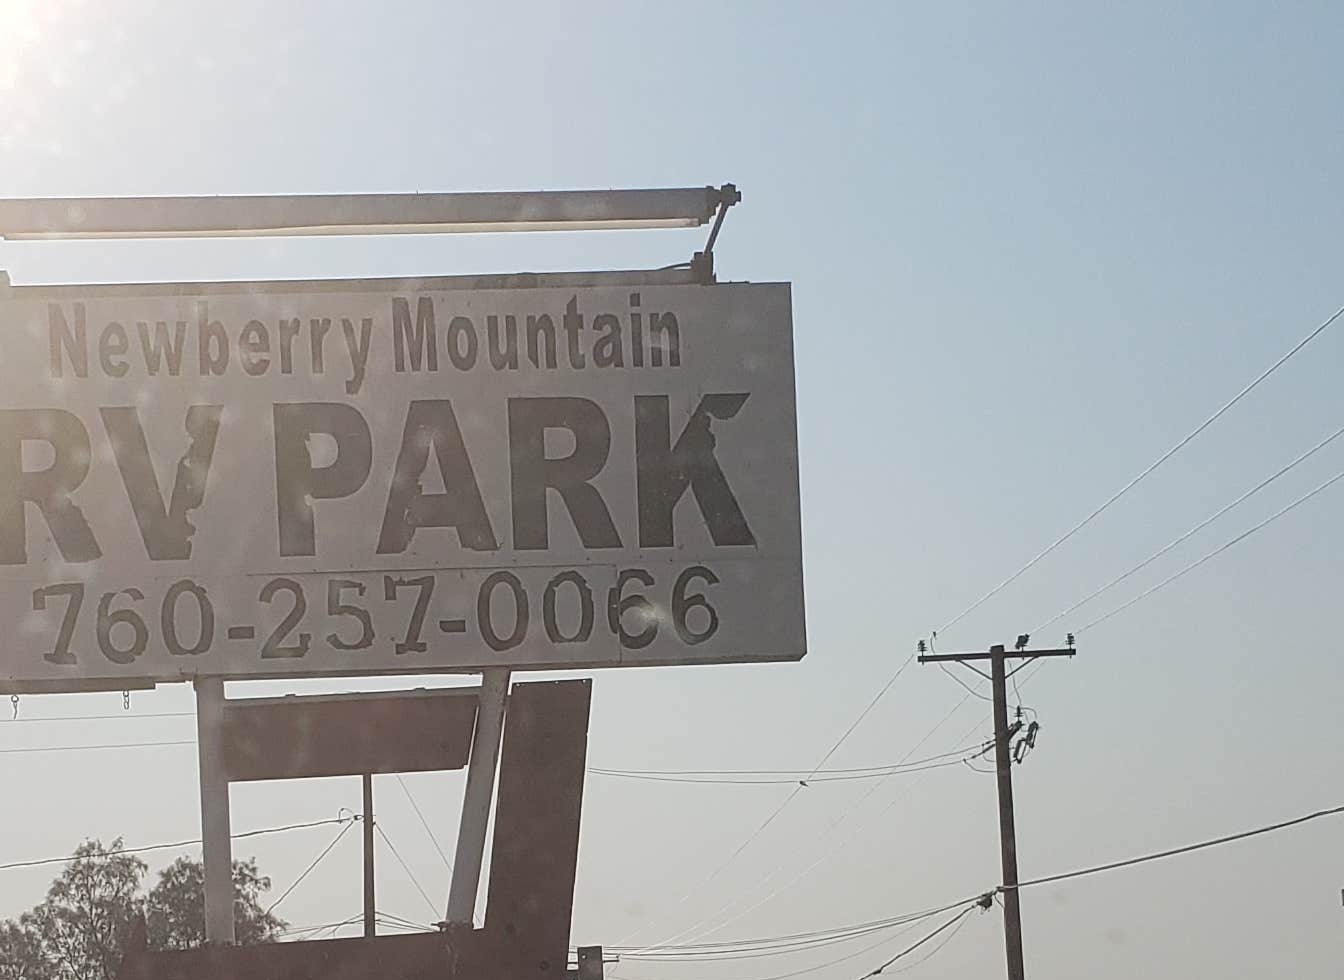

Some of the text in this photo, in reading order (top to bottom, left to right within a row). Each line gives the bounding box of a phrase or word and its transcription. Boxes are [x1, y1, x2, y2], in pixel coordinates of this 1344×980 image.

[46, 293, 682, 394] Newberry Mountain
[273, 392, 757, 558] PARK
[31, 566, 722, 665] 760-257-0066
